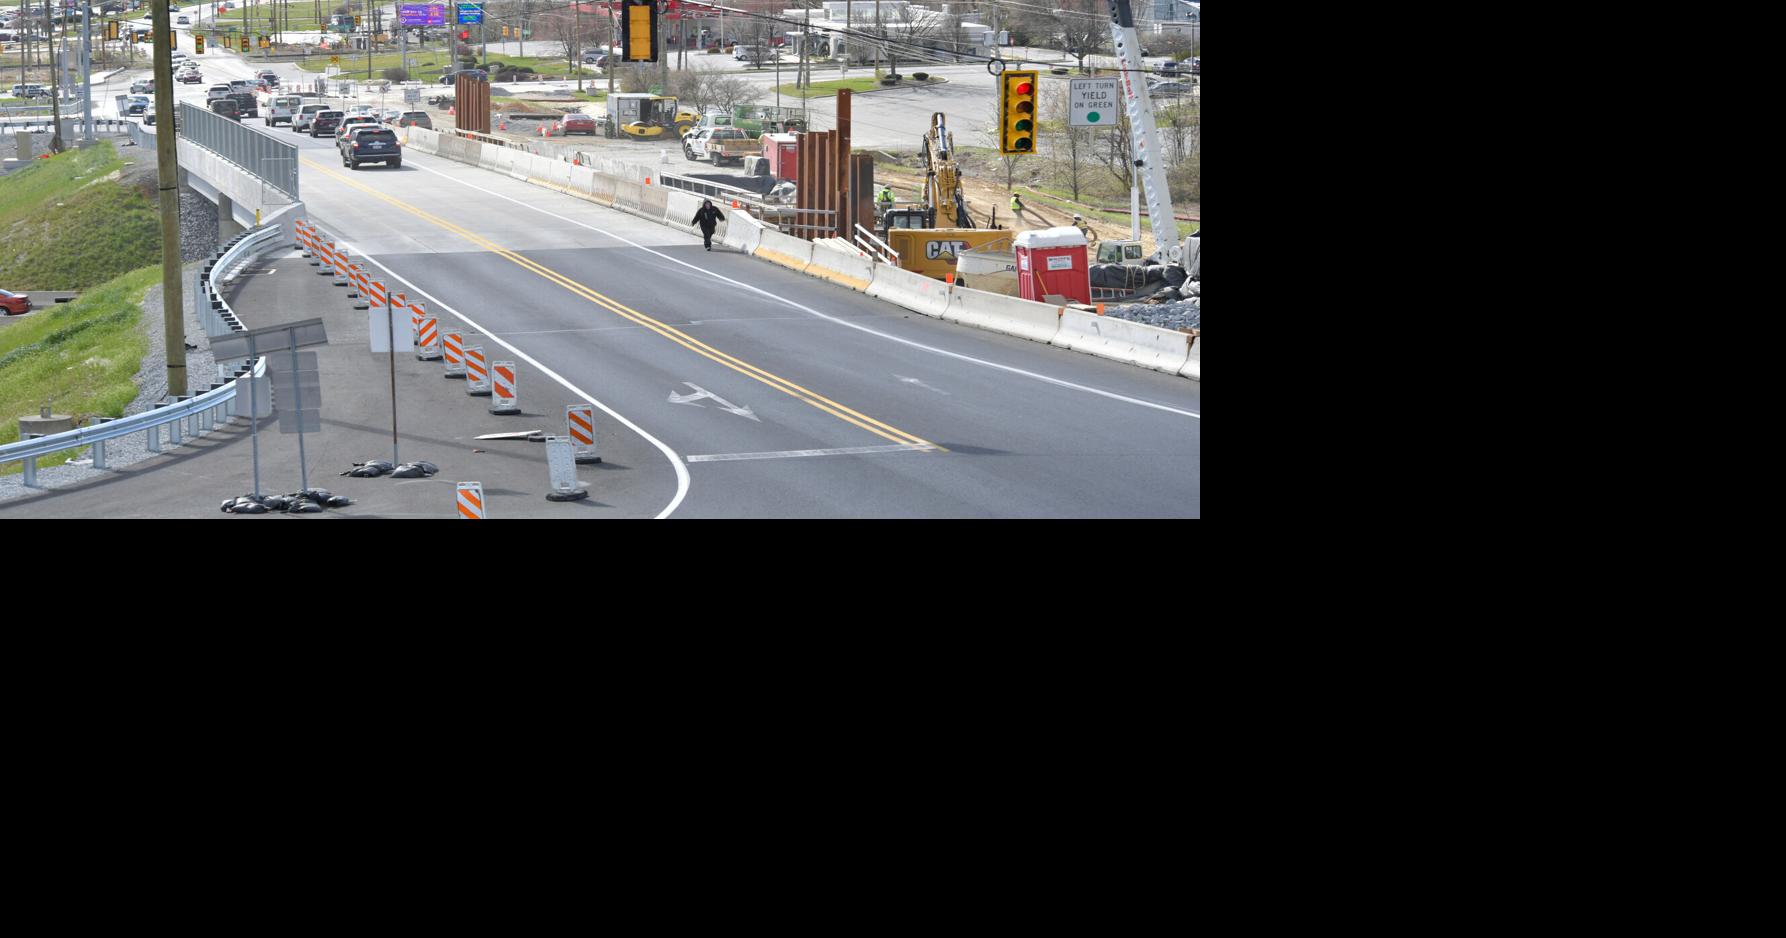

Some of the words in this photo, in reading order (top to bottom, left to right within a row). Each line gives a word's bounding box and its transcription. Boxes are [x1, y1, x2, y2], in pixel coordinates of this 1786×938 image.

[1074, 82, 1091, 90] LEFT
[1088, 101, 1113, 109] GREEN
[926, 241, 963, 259] CAT
[1006, 264, 1016, 272] GA
